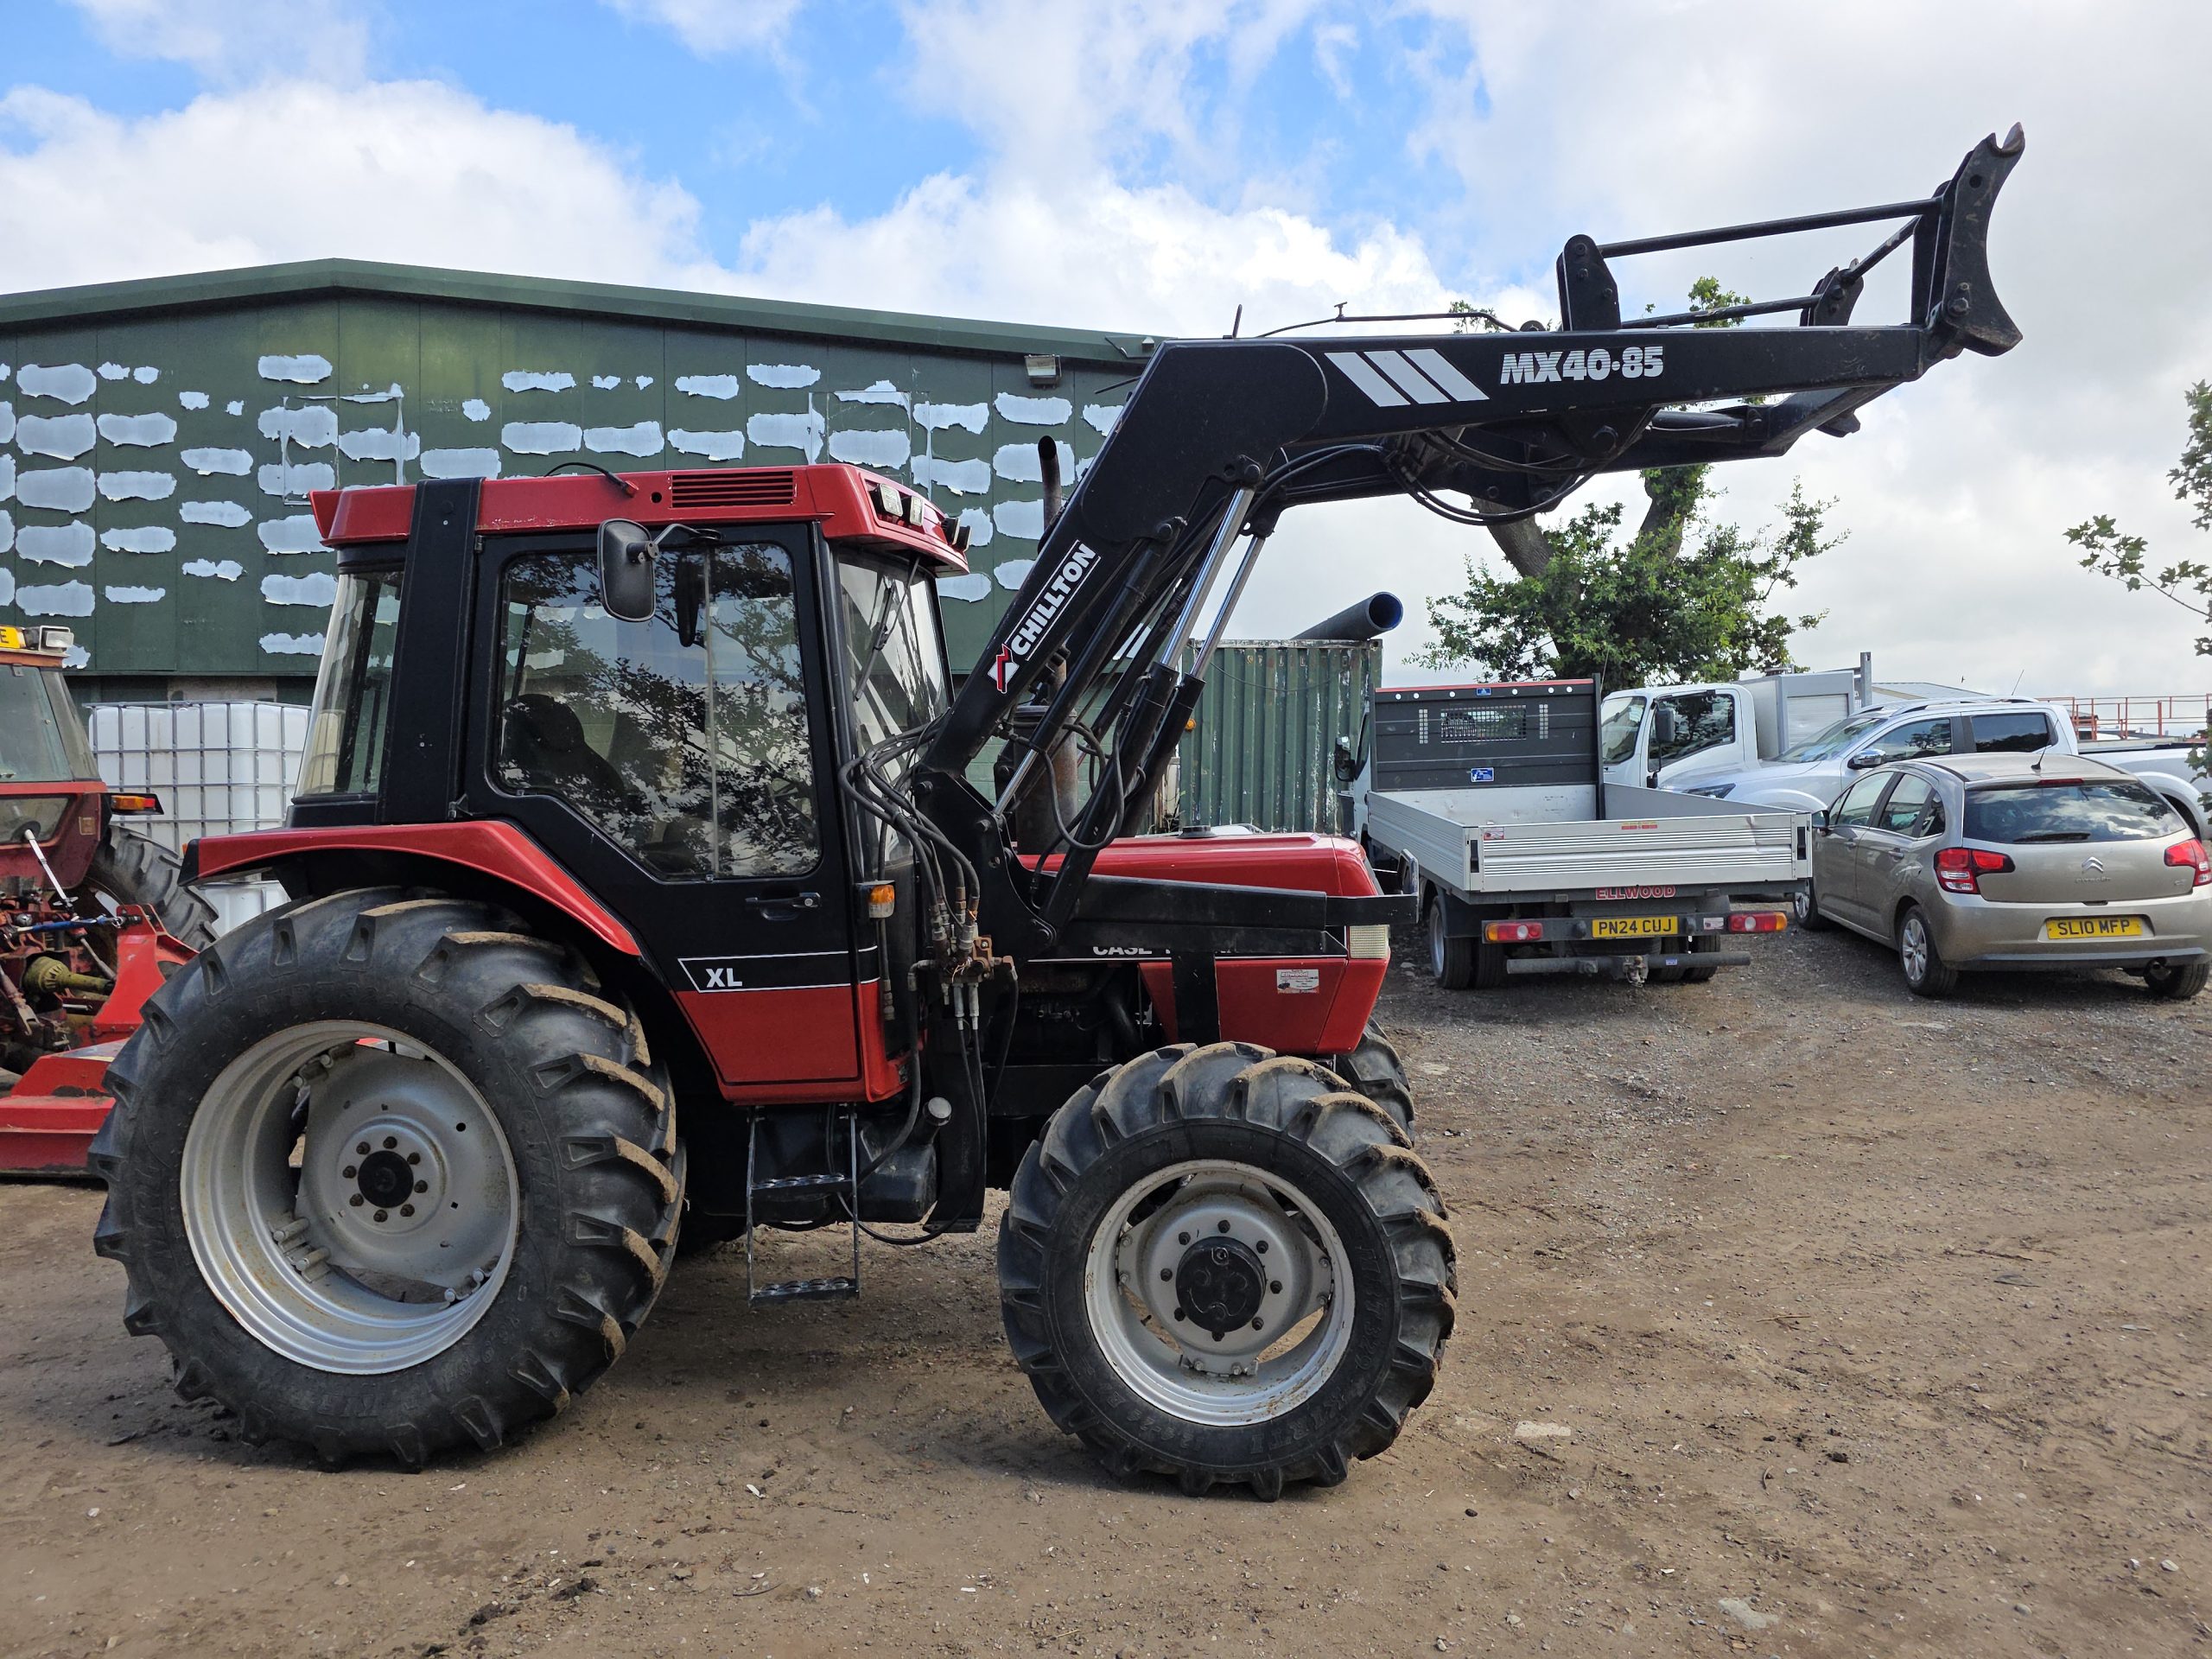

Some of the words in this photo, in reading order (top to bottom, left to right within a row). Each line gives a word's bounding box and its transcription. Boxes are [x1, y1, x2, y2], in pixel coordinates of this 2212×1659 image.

[1011, 543, 1096, 656] CHILLTON
[1595, 886, 1676, 900] ELLWOOD
[1599, 920, 1637, 935] PN24
[1643, 918, 1671, 932] CUJ
[2056, 920, 2094, 935] SL10
[2099, 918, 2130, 933] MFP
[706, 968, 743, 988] XL
